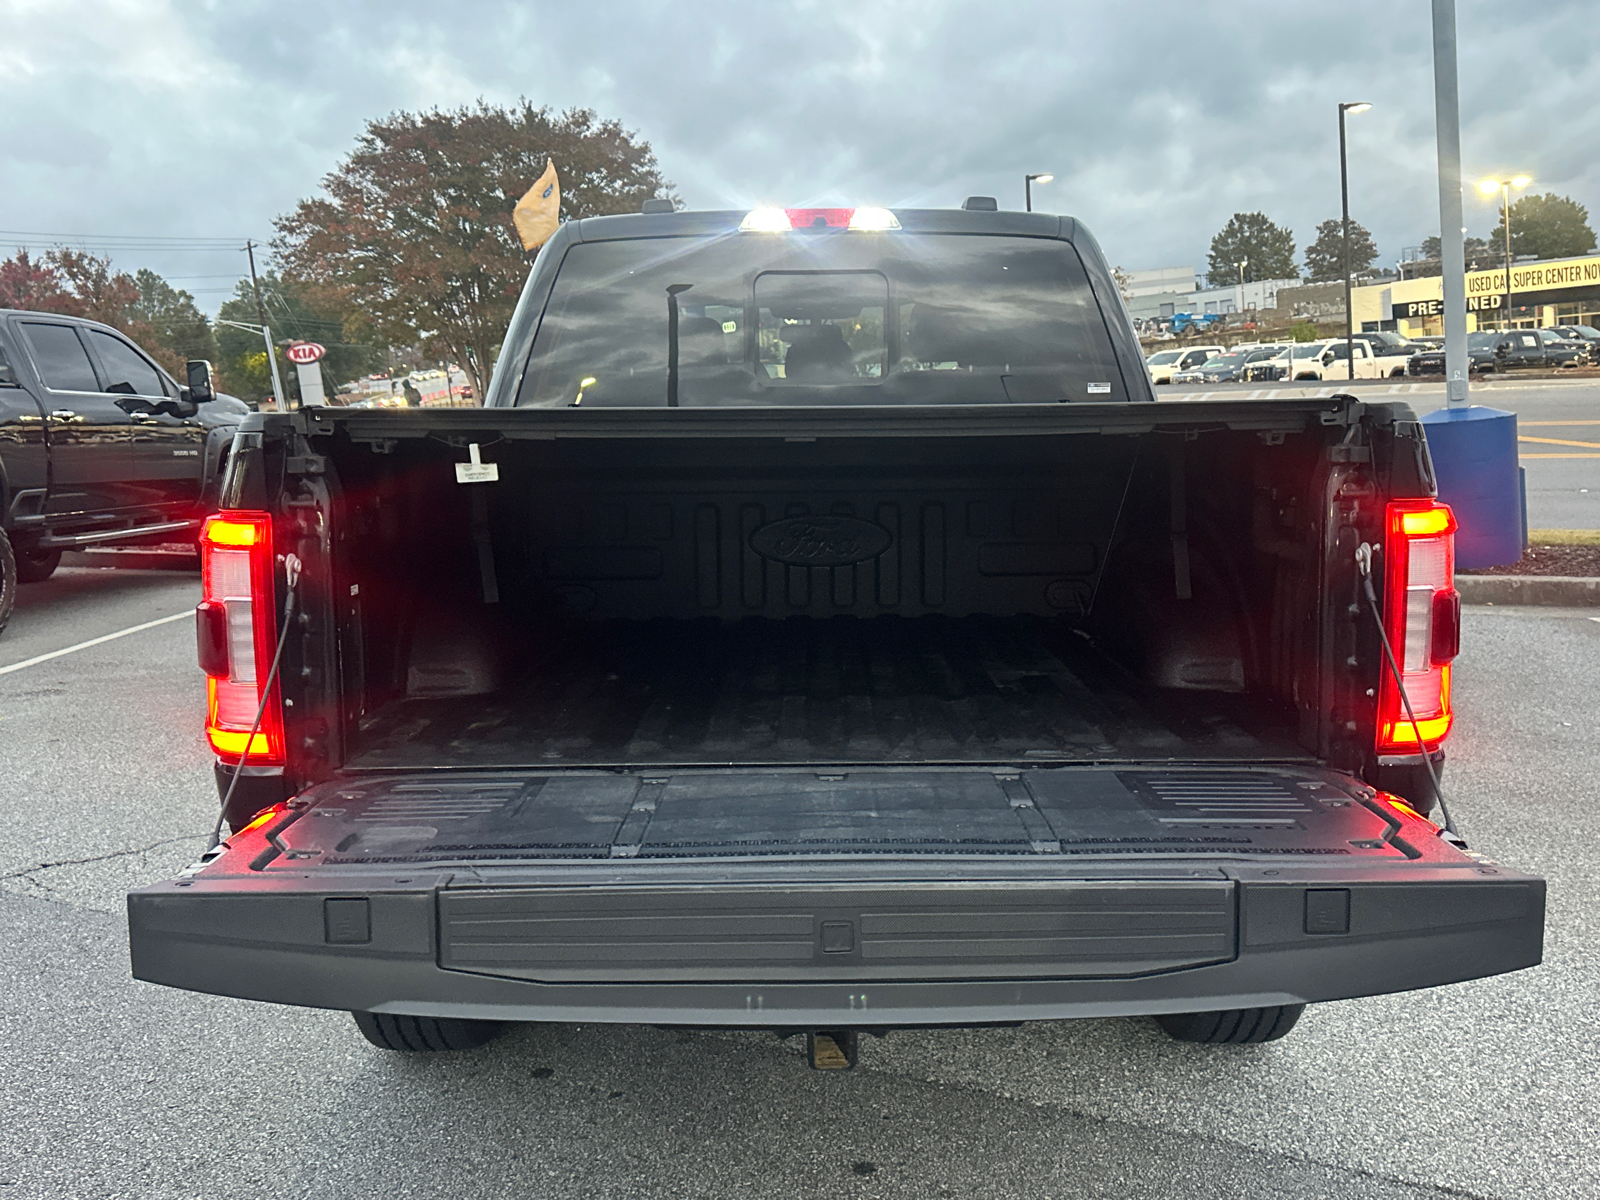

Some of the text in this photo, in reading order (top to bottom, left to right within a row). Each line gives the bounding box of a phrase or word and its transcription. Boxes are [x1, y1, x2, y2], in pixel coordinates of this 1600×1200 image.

[1469, 263, 1600, 292] USED CA SUPER CENTER NO
[292, 347, 318, 359] KIA
[774, 523, 865, 557] Ford
